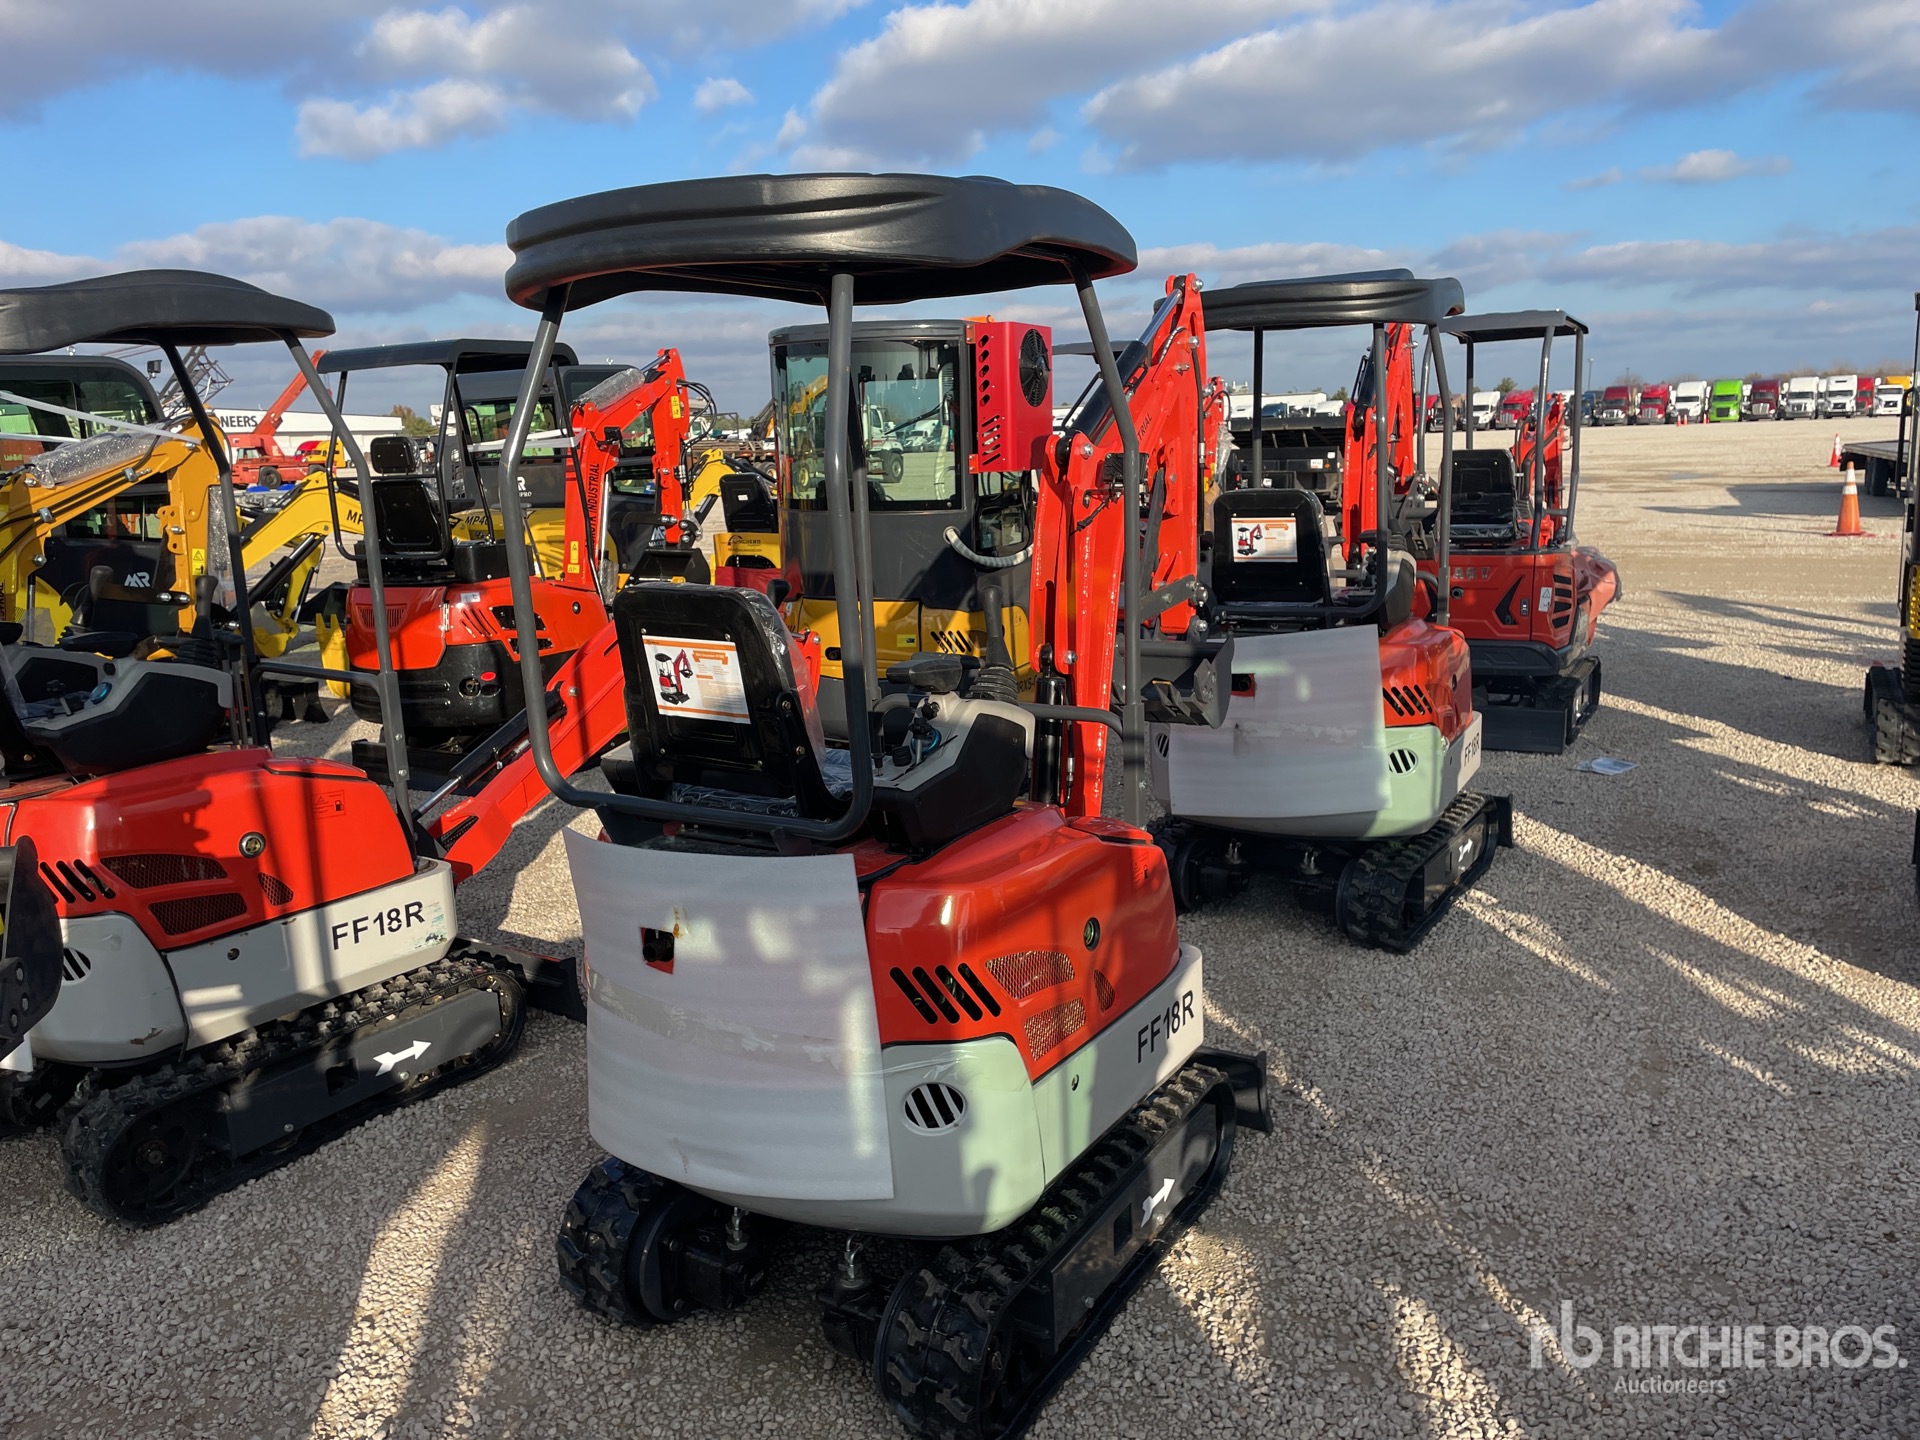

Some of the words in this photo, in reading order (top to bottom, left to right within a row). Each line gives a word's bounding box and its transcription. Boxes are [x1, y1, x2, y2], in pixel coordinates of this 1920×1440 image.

[220, 415, 258, 428] NEERS
[1137, 412, 1153, 441] TRIAL
[587, 463, 600, 514] INDUSTRIAL
[346, 509, 364, 525] MP
[332, 901, 425, 950] FF18R
[1138, 990, 1194, 1063] FF18R
